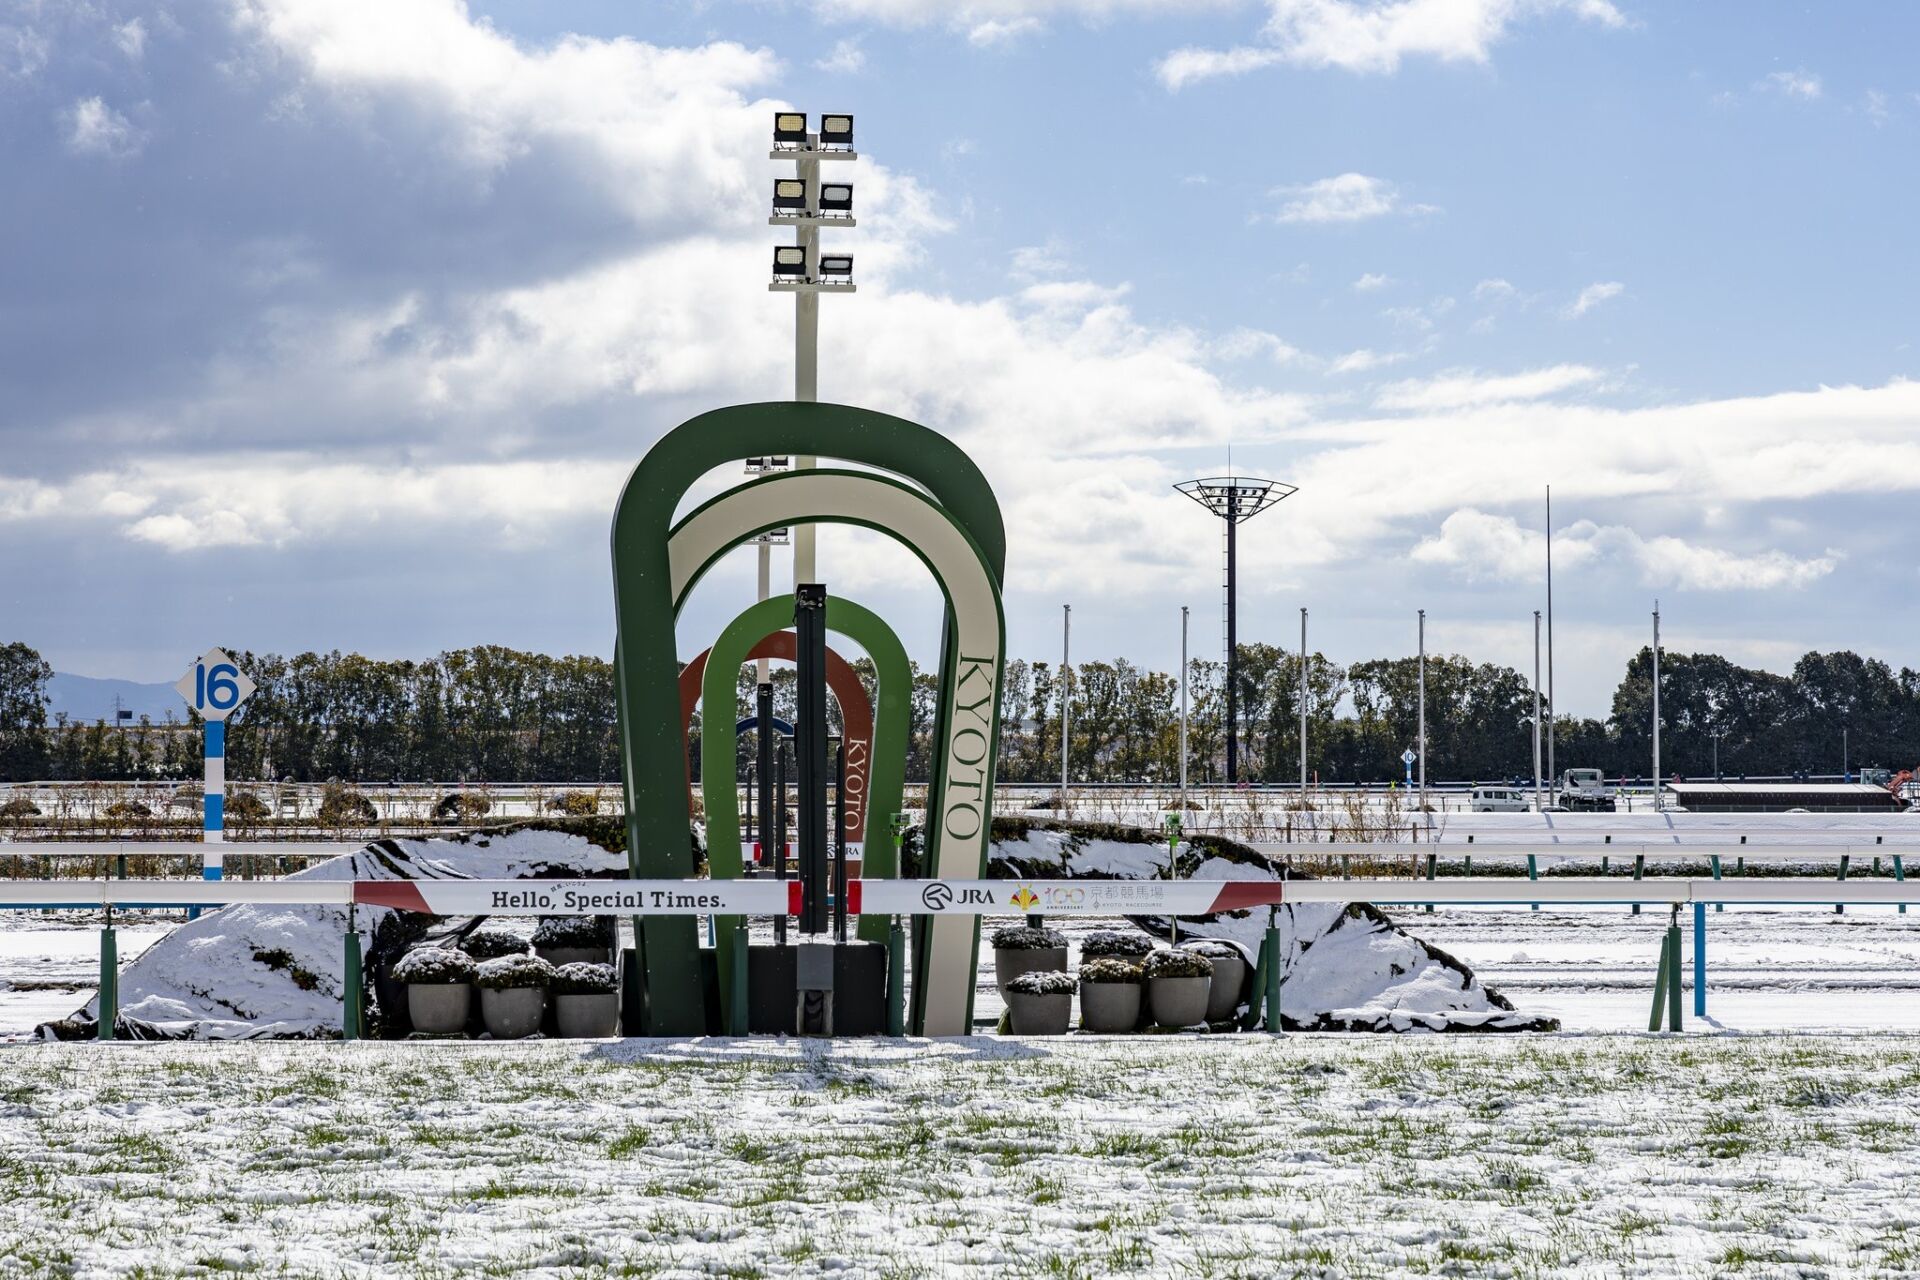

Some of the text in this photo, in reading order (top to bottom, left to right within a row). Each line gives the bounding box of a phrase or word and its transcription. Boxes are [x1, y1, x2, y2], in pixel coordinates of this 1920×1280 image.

[196, 663, 239, 710] 16
[945, 651, 995, 841] KYOTO
[844, 737, 868, 830] KYOTO
[491, 891, 726, 912] Hello, Special Times.
[957, 889, 995, 904] JRA
[1090, 886, 1164, 902] 京都競馬場
